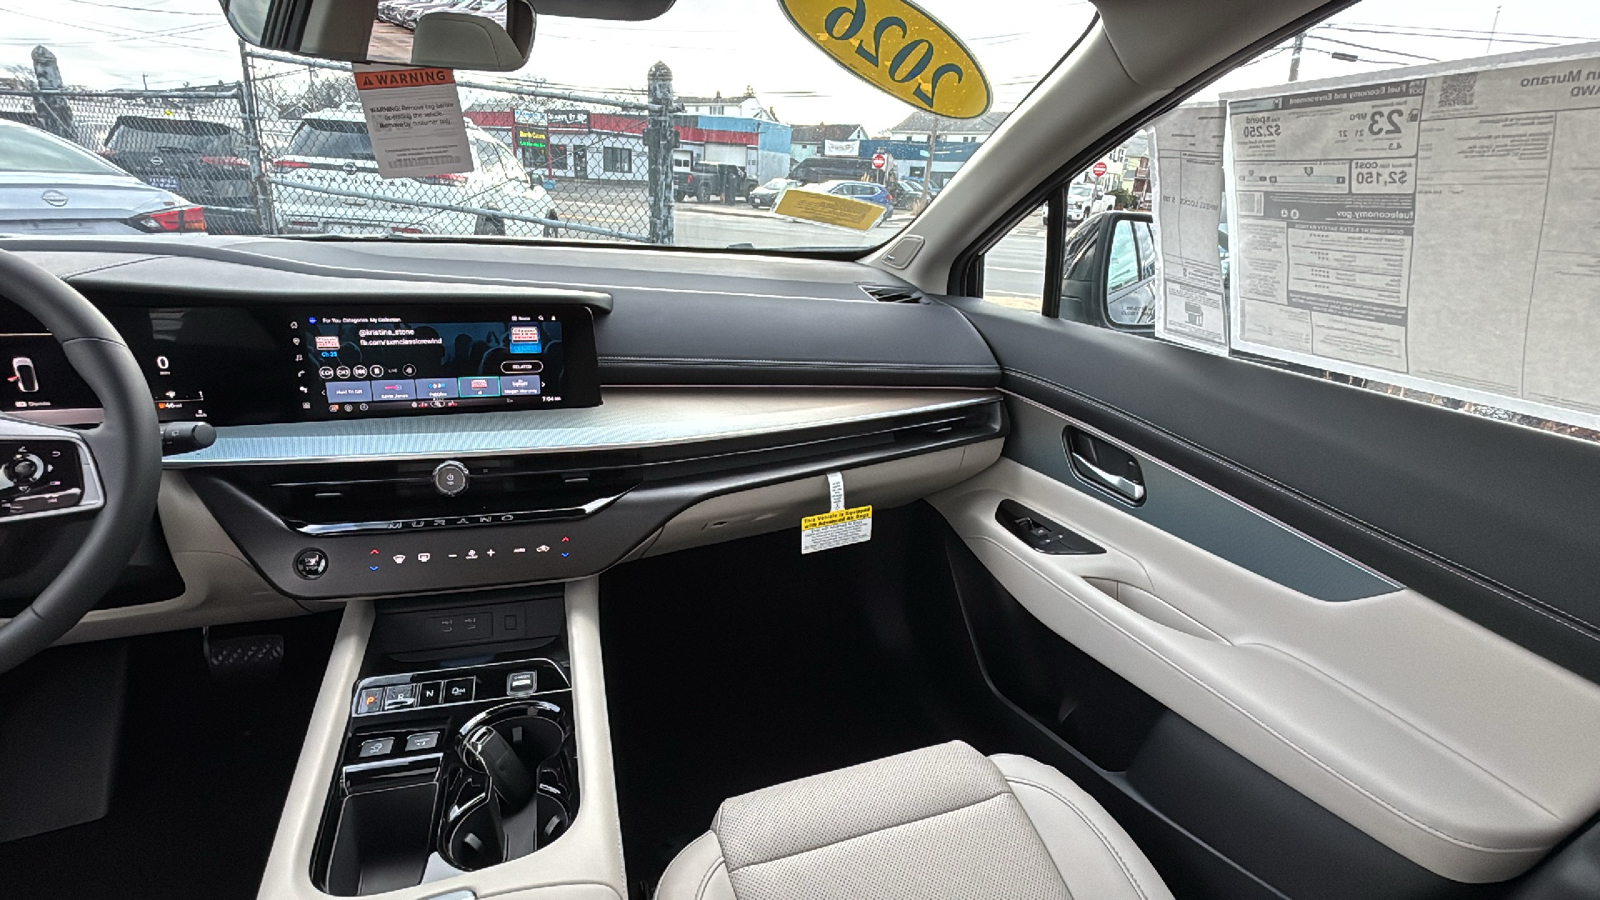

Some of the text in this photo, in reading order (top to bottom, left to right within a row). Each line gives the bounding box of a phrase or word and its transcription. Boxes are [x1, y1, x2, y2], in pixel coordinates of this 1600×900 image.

[375, 70, 446, 86] WARNING
[157, 356, 169, 369] 0
[387, 514, 514, 529] MURANO
[426, 689, 434, 698] N
[366, 696, 375, 705] P
